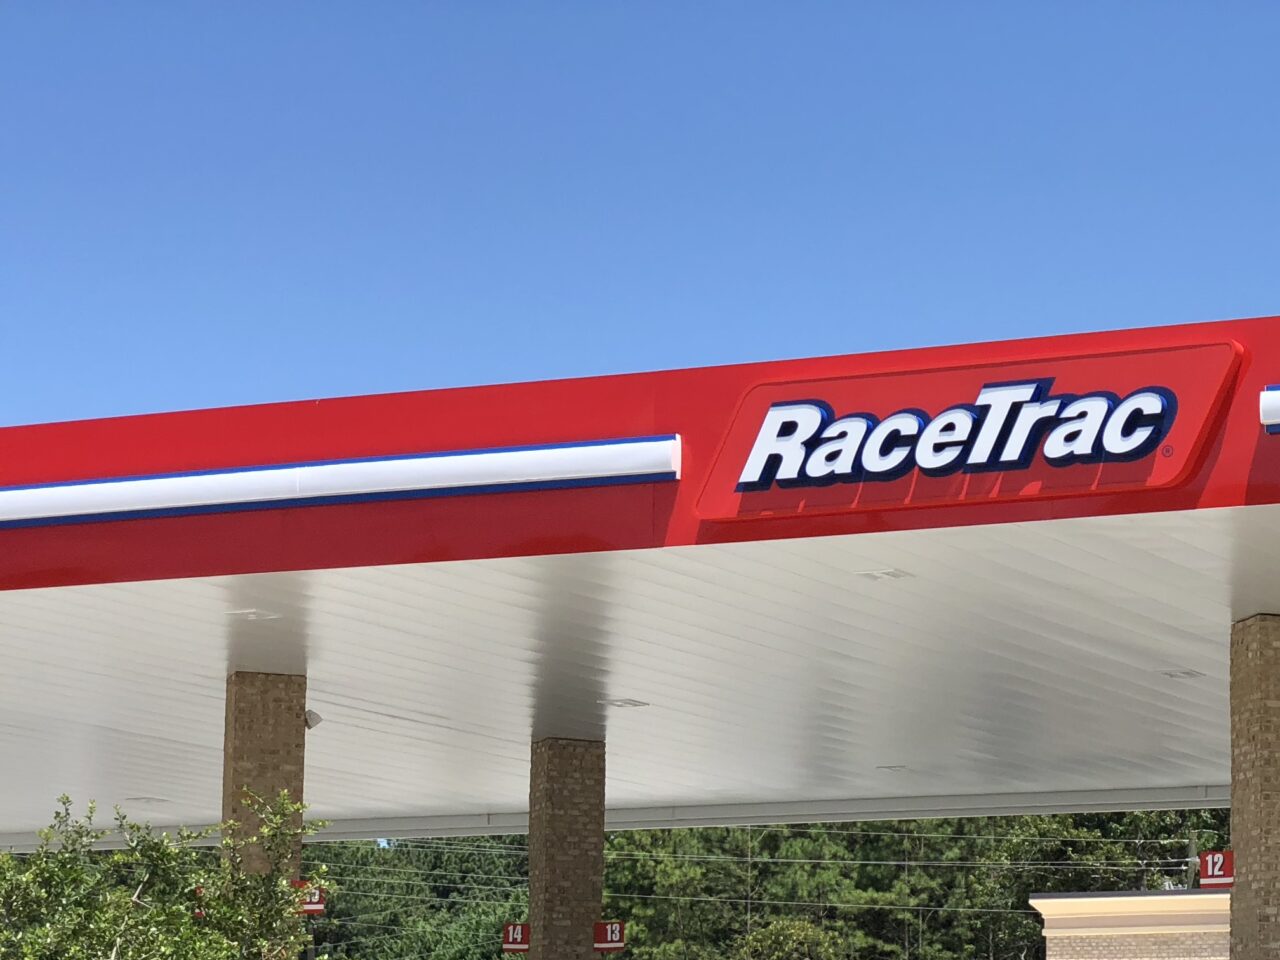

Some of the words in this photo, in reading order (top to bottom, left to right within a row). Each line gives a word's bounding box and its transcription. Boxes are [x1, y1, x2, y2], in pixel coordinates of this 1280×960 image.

[736, 378, 1177, 490] RaceTrac
[1205, 853, 1224, 876] 12
[507, 925, 523, 943] 14
[606, 923, 620, 941] 13
